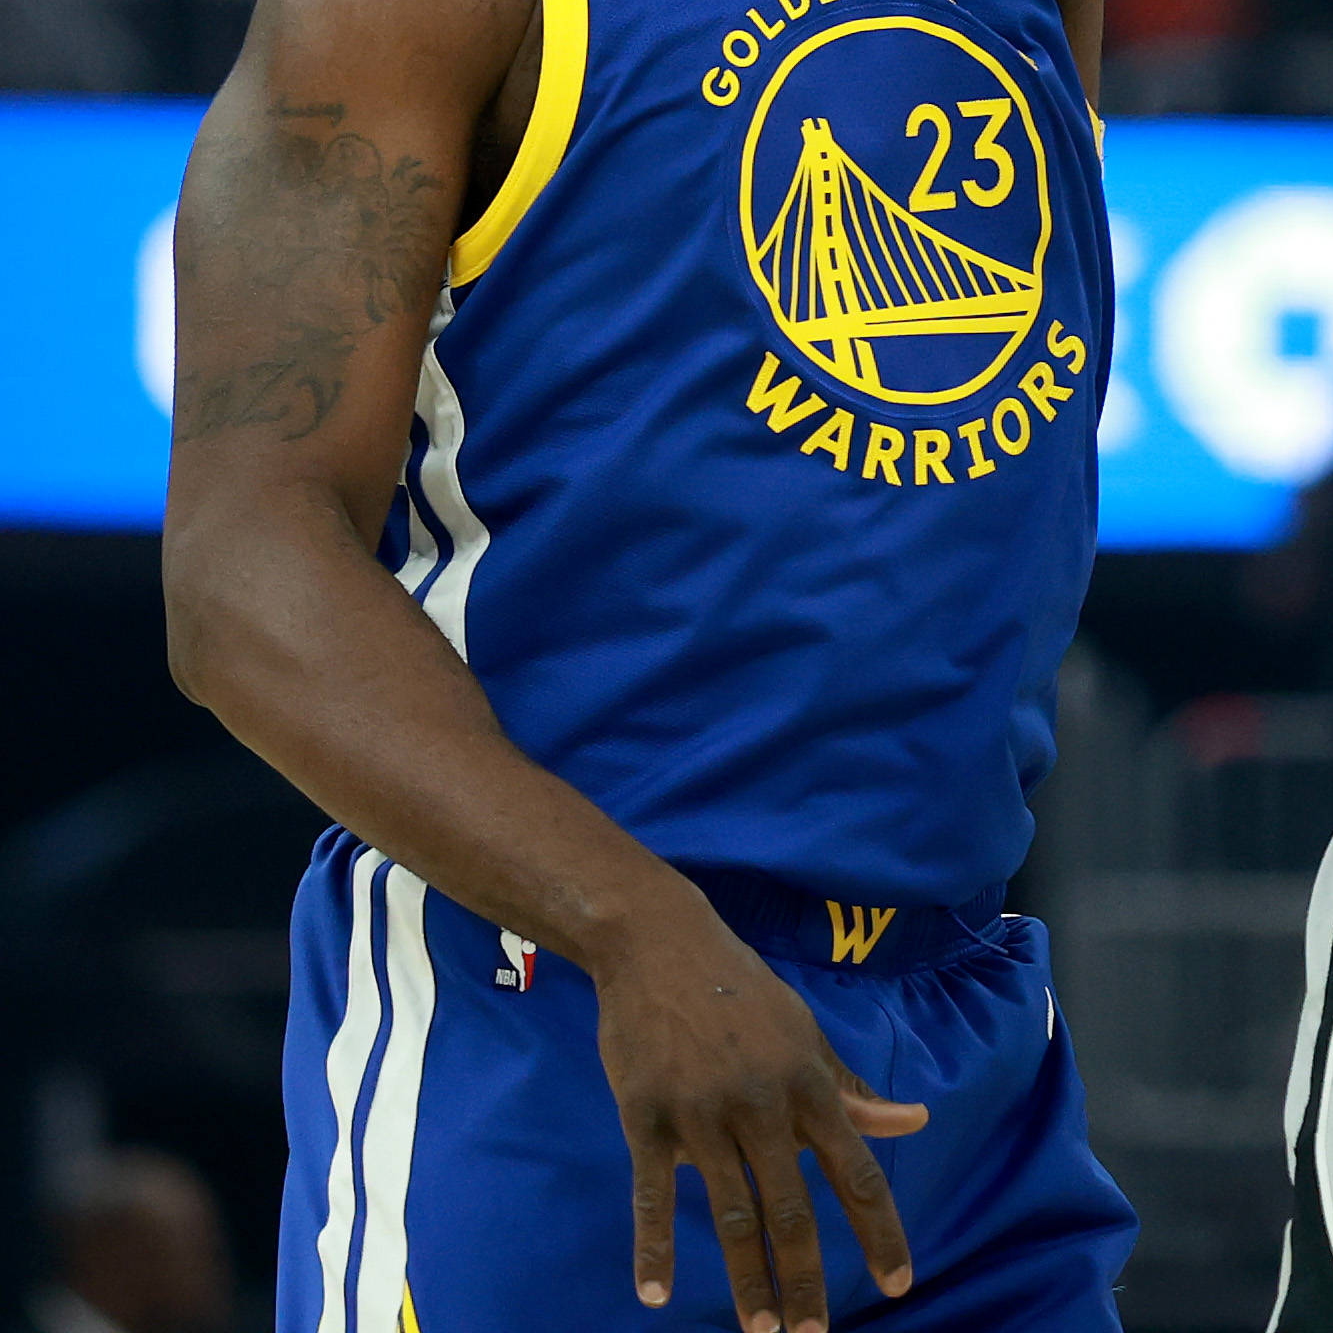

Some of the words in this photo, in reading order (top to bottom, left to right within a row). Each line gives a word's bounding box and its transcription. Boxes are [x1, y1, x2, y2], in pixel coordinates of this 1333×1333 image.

[904, 98, 1017, 214] 23
[743, 320, 1088, 487] WARRIORS
[825, 899, 897, 964] W
[495, 968, 517, 987] NBA
